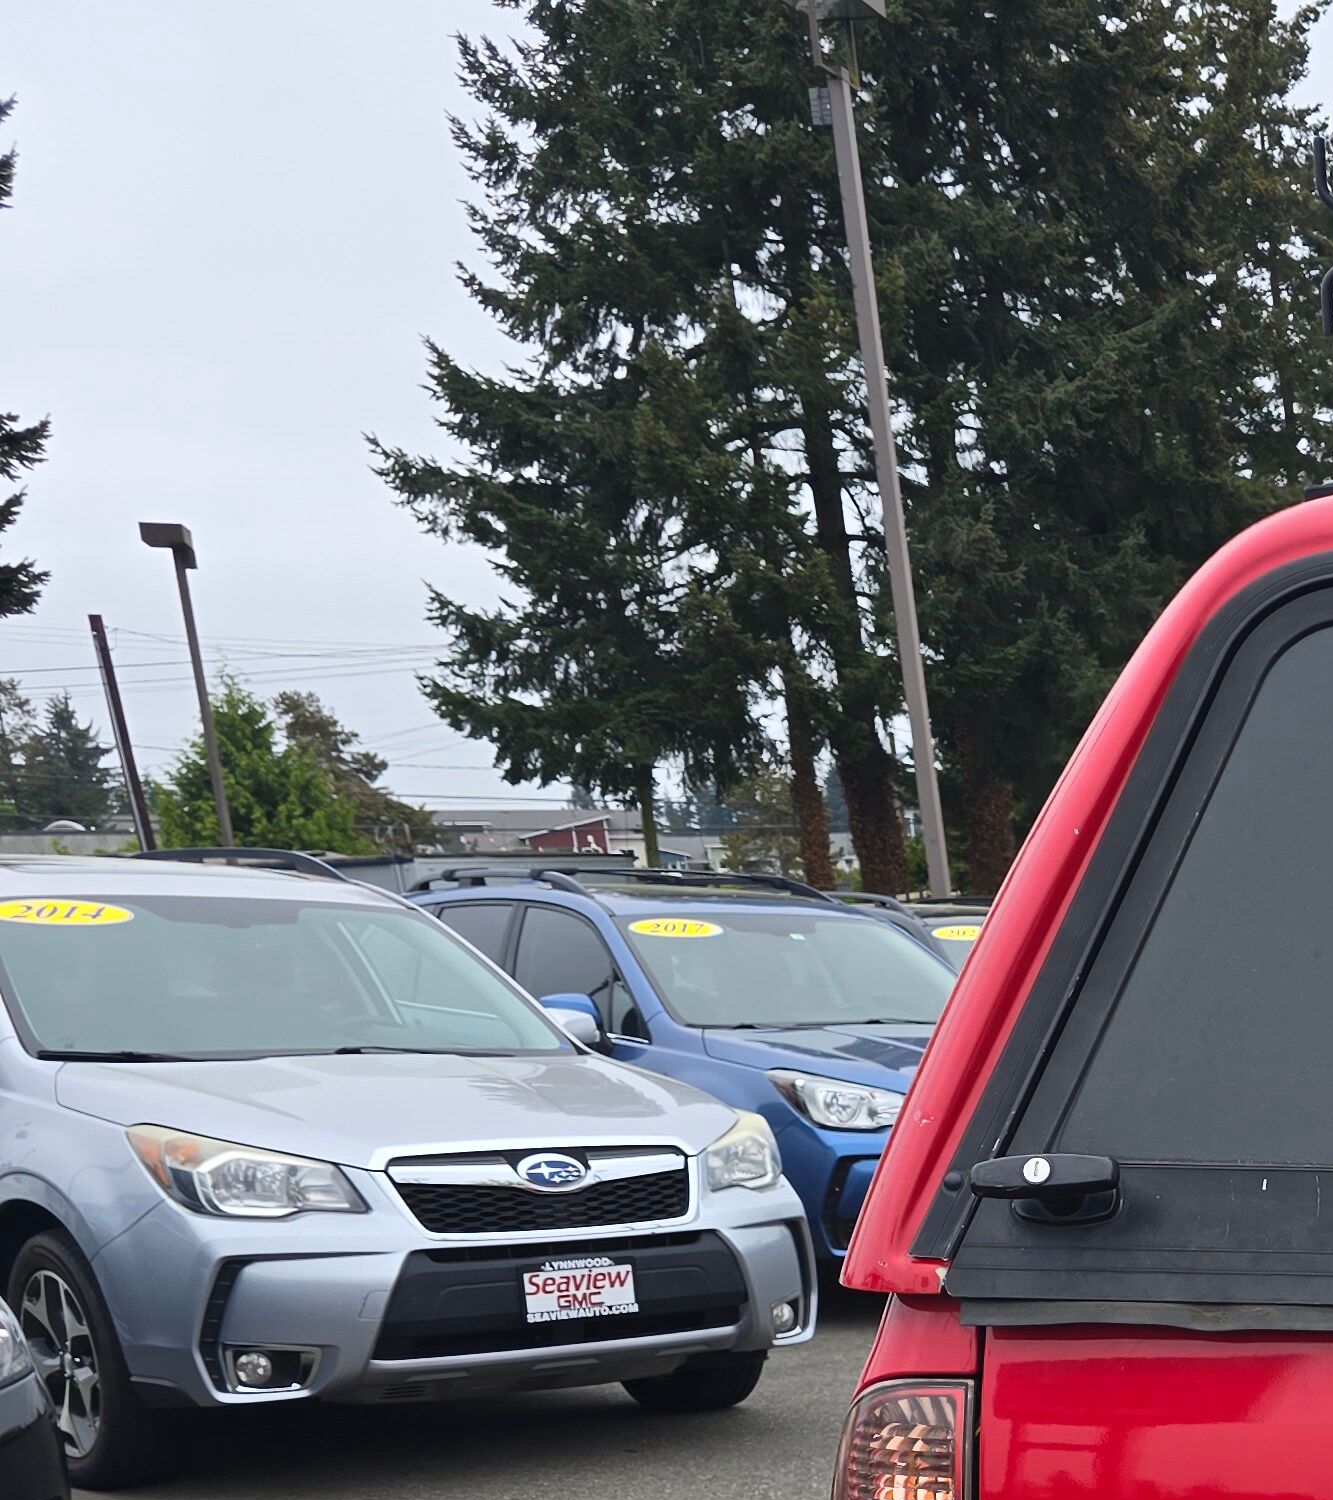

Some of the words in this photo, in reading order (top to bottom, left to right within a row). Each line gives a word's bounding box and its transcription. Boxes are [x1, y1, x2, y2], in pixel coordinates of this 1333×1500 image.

[10, 904, 106, 919] 2014
[650, 923, 705, 933] 2017
[544, 1257, 611, 1271] LYNNWOOD
[525, 1269, 630, 1296] Seaview
[556, 1291, 604, 1309] GMC
[526, 1303, 639, 1323] SEAVIEWAUTO.COM
